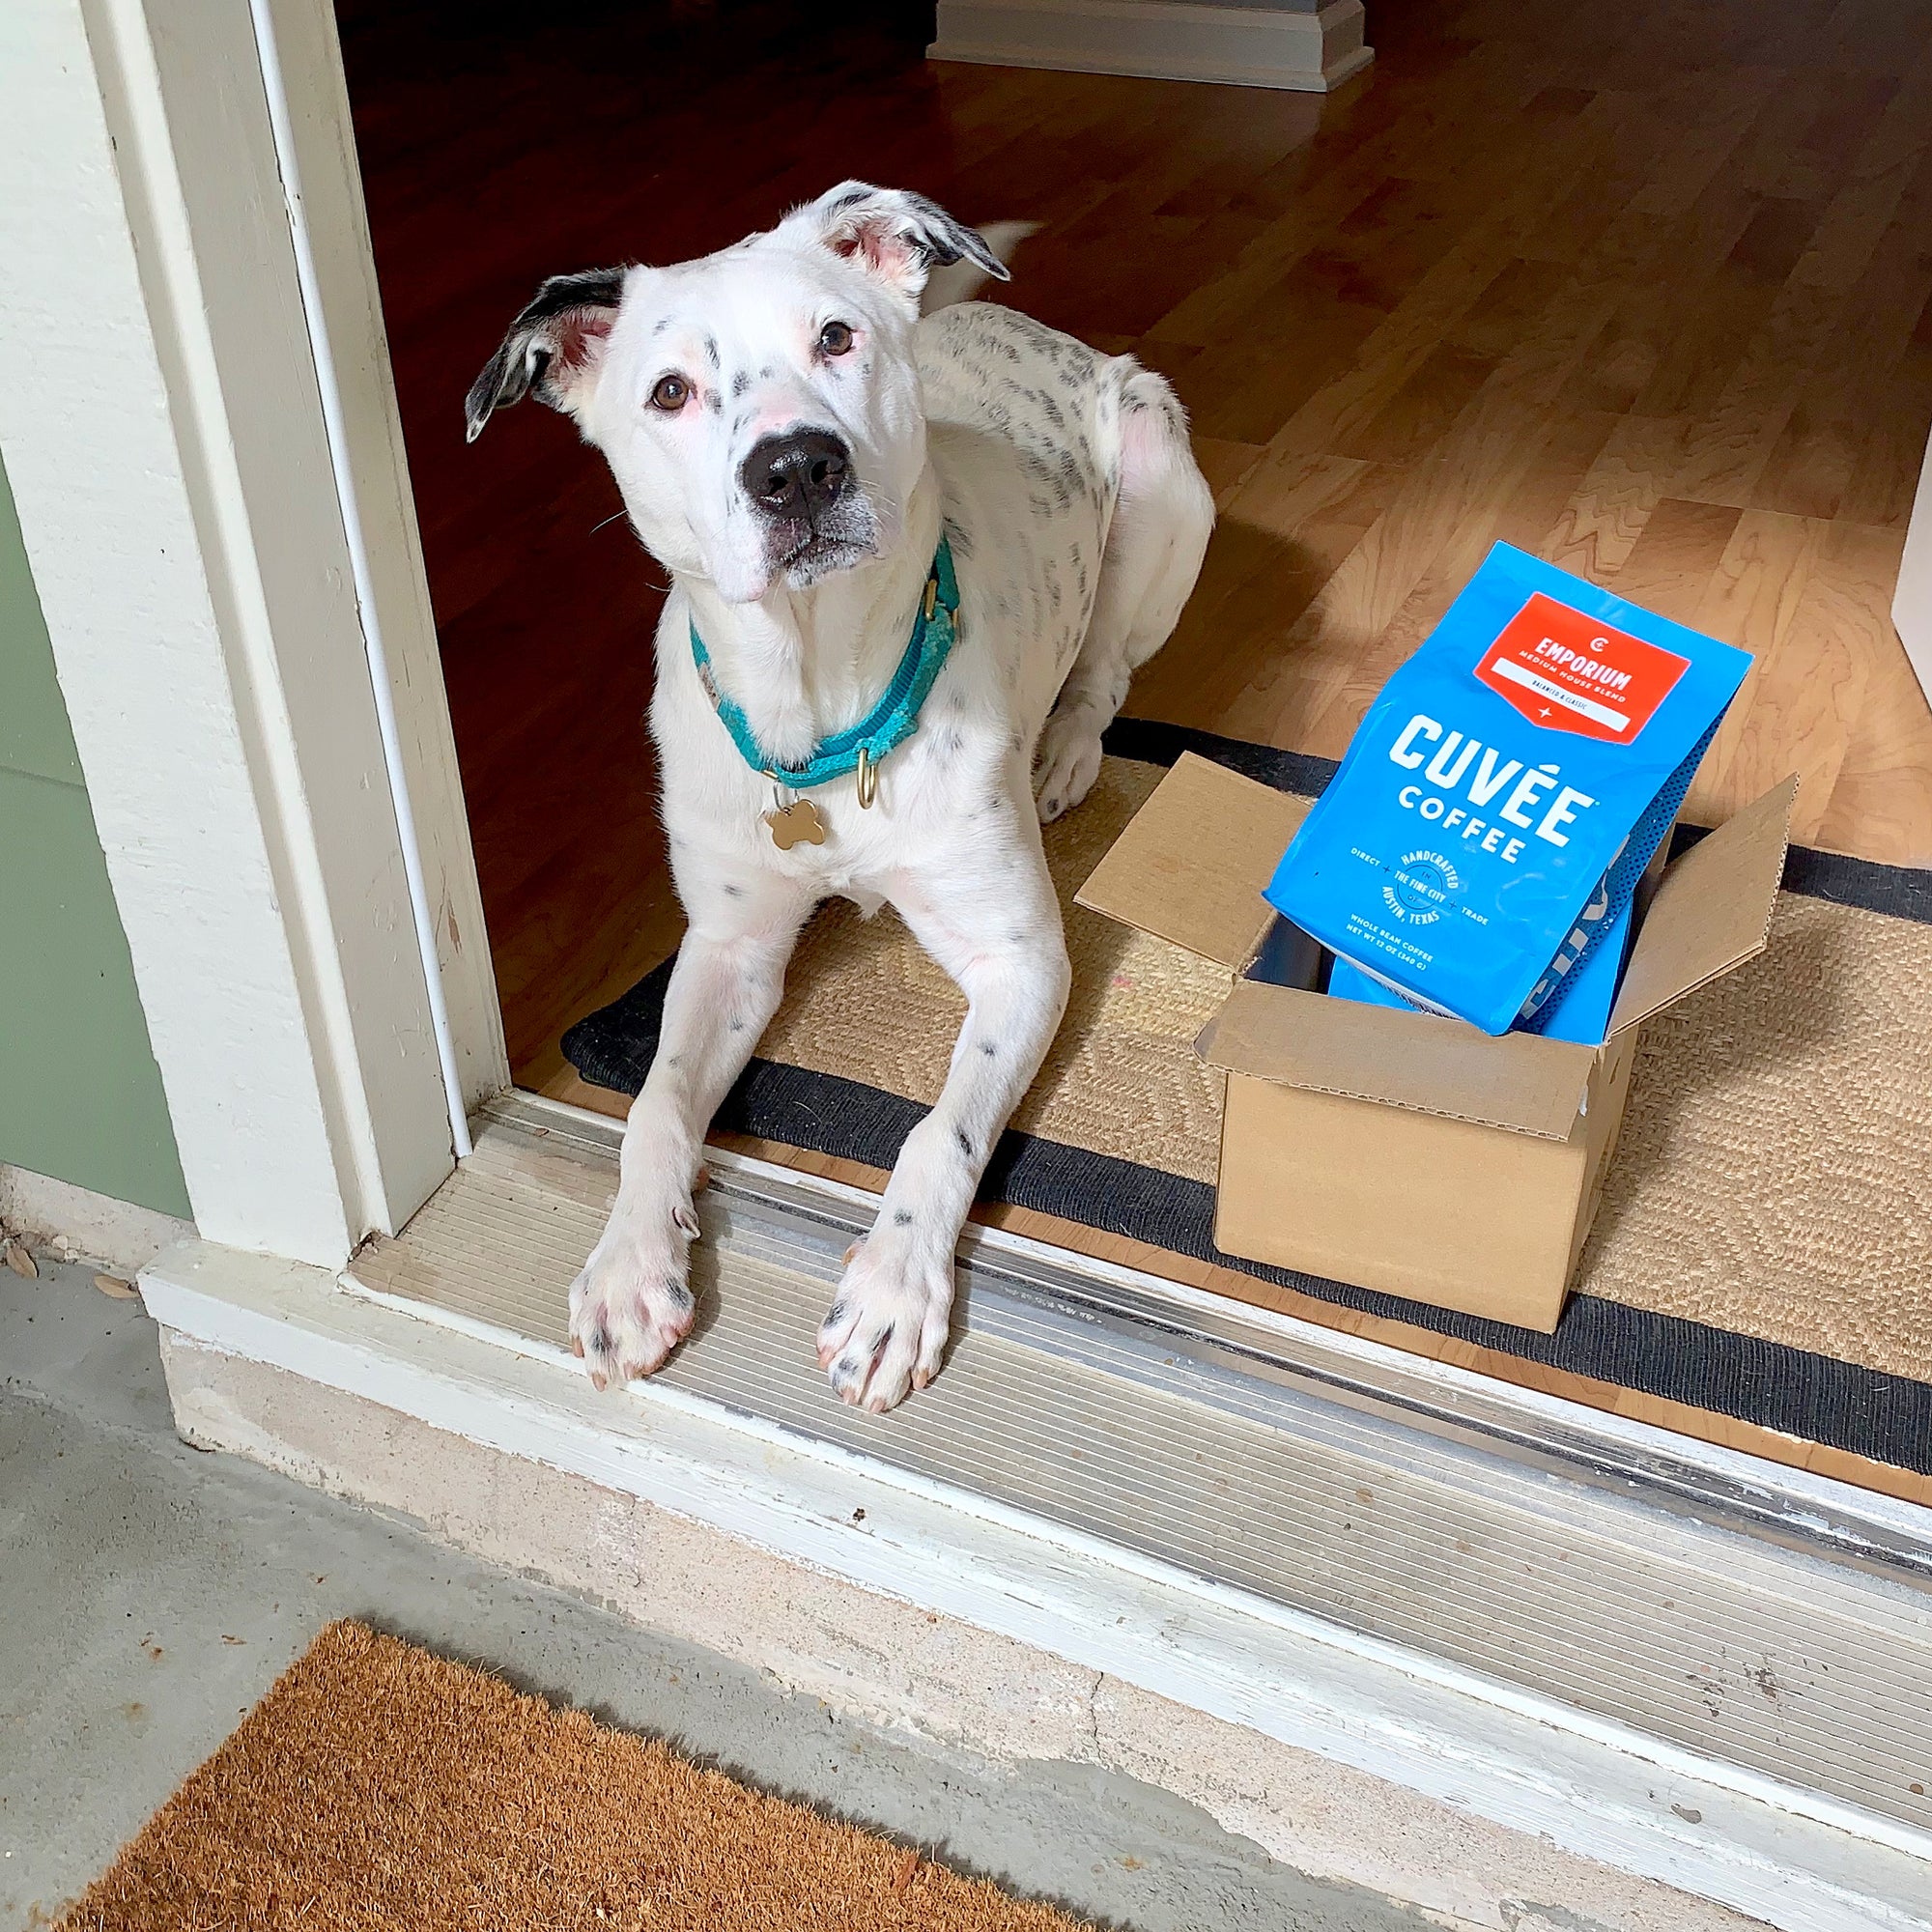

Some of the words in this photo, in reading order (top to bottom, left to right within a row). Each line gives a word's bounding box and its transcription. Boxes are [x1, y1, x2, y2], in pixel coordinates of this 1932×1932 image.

[1519, 650, 1557, 672] MEDIUM
[1559, 670, 1593, 689] HOUSE
[1594, 686, 1626, 702] BLEND
[1535, 637, 1633, 691] EMPORIUM
[1532, 680, 1560, 696] BALANCED
[1565, 696, 1587, 710] CLASSIC
[1389, 714, 1596, 848] CUVÉE
[1398, 785, 1526, 865] COFFEE
[1350, 847, 1381, 867] DIRECT
[1461, 906, 1490, 925] TRADE
[1394, 870, 1409, 884] THE
[1408, 878, 1428, 894] FINE
[1427, 889, 1446, 903] CITY
[1401, 850, 1459, 890] HANDCRAFTED
[1382, 886, 1406, 923] AUSTIN,
[1409, 910, 1440, 924] TEXAS
[1346, 923, 1362, 935] NET
[1363, 932, 1376, 943] WT
[1376, 939, 1384, 948] 12
[1385, 945, 1398, 954] OZ
[1397, 952, 1416, 964] (340
[1416, 962, 1427, 971] G)
[1350, 913, 1378, 933] WHOLE
[1379, 929, 1402, 945] BEAN
[1402, 942, 1434, 963] COFFEE
